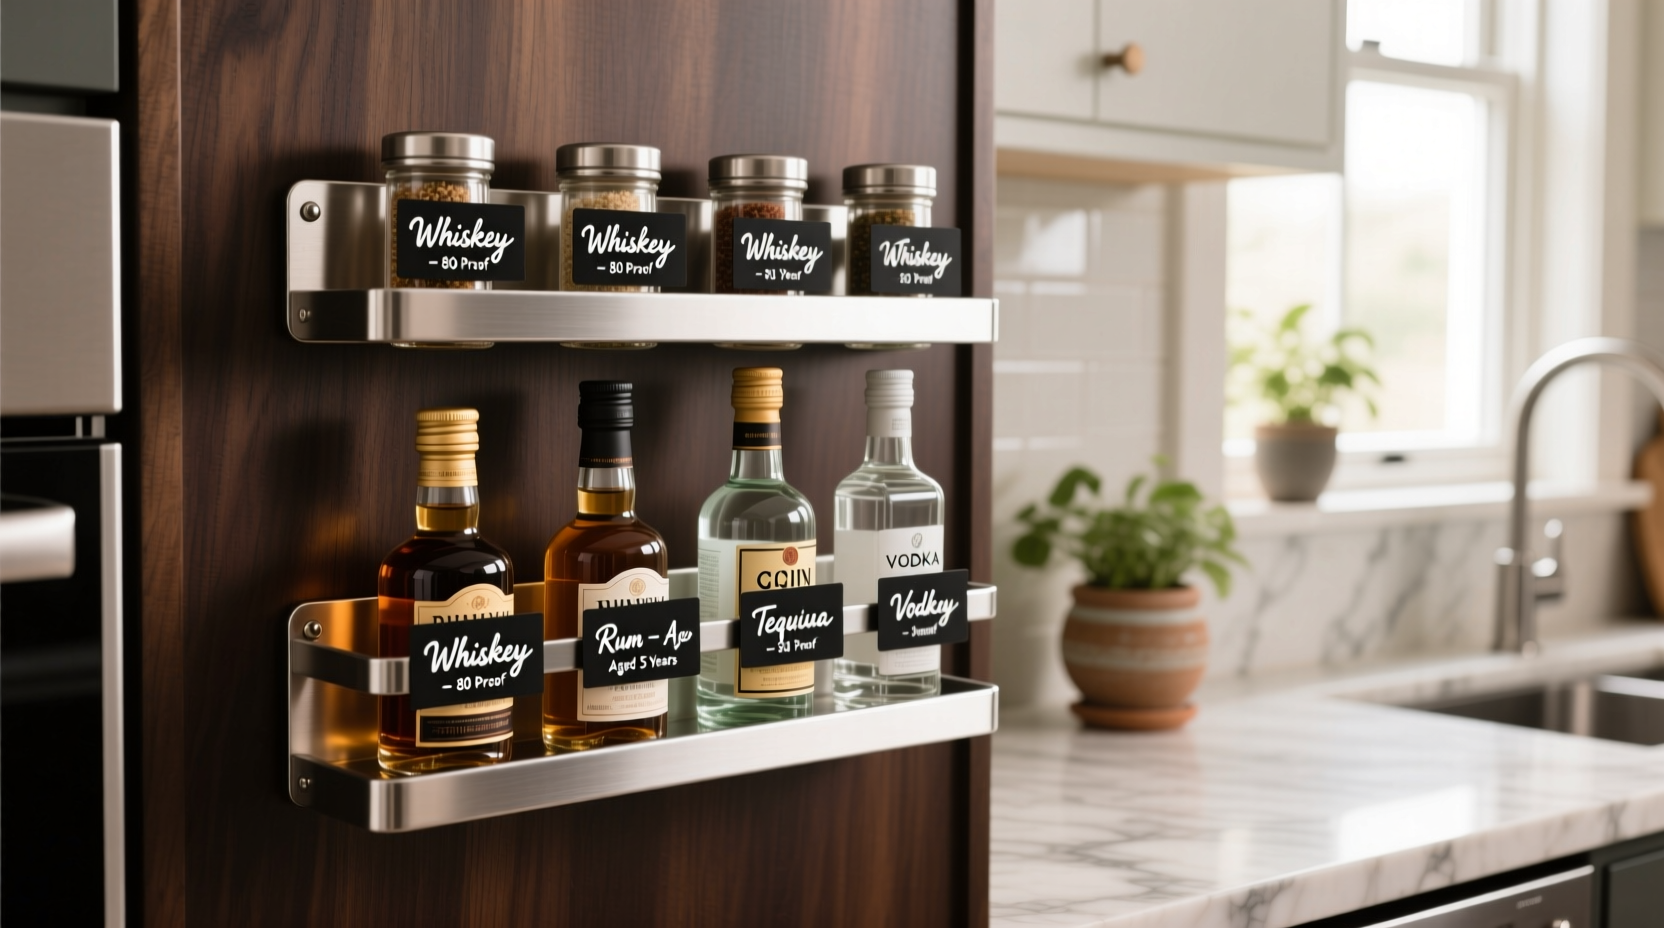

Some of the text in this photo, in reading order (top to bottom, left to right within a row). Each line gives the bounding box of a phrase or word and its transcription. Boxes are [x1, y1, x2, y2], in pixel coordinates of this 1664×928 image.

[408, 215, 515, 264] Whiskey
[580, 224, 676, 268] Whiskey
[441, 256, 458, 270] 80
[740, 231, 824, 274] Whiskey
[609, 261, 624, 275] 80
[885, 551, 940, 569] VODKA
[595, 623, 643, 655] Rum
[422, 632, 534, 677] Whiskey
[639, 655, 648, 669] 5
[456, 677, 472, 691] 80
